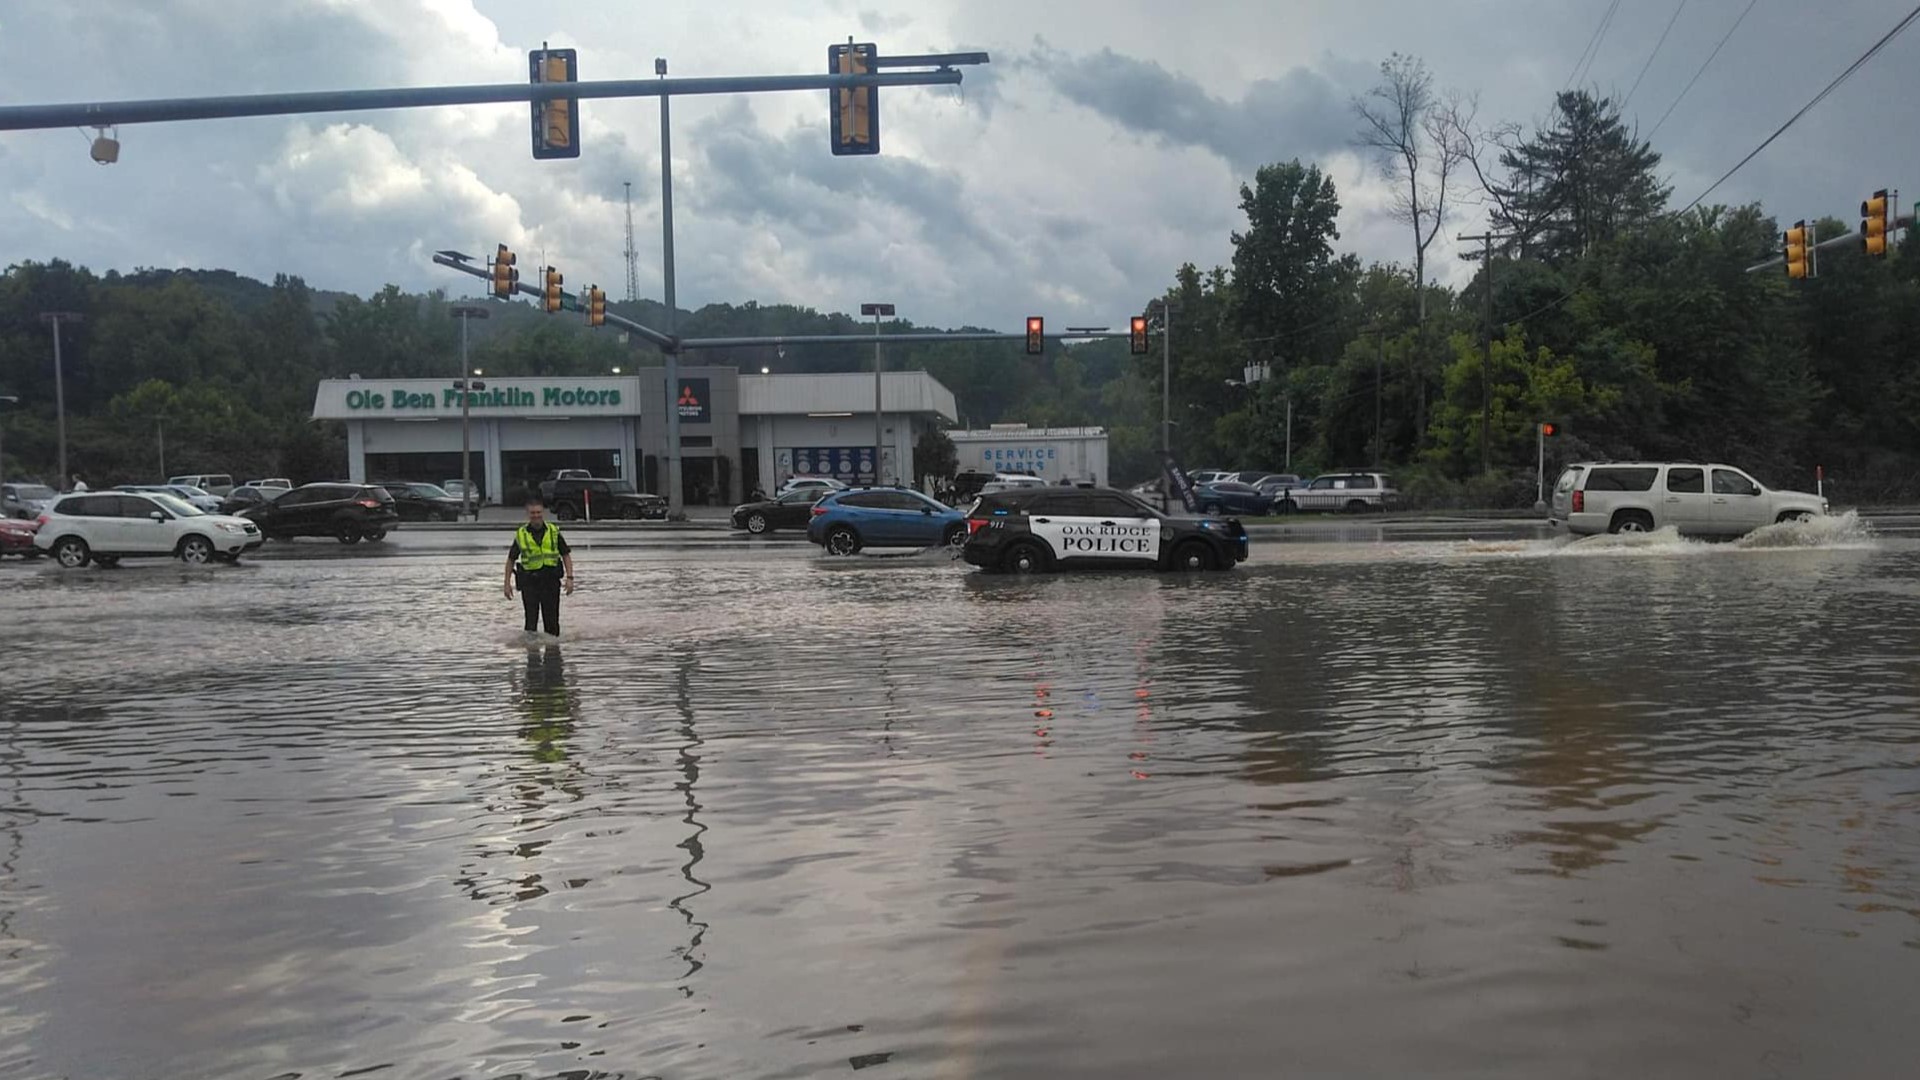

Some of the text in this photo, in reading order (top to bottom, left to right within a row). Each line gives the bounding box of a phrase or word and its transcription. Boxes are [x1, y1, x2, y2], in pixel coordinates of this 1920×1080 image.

[346, 387, 621, 410] Ole Ben Franklin Motors
[984, 449, 1055, 461] SERVICE
[995, 461, 1044, 472] PARTS
[989, 520, 1005, 529] 911
[1062, 526, 1094, 535] OAK
[1100, 526, 1151, 537] RIDGE
[1063, 537, 1150, 553] POLICE
